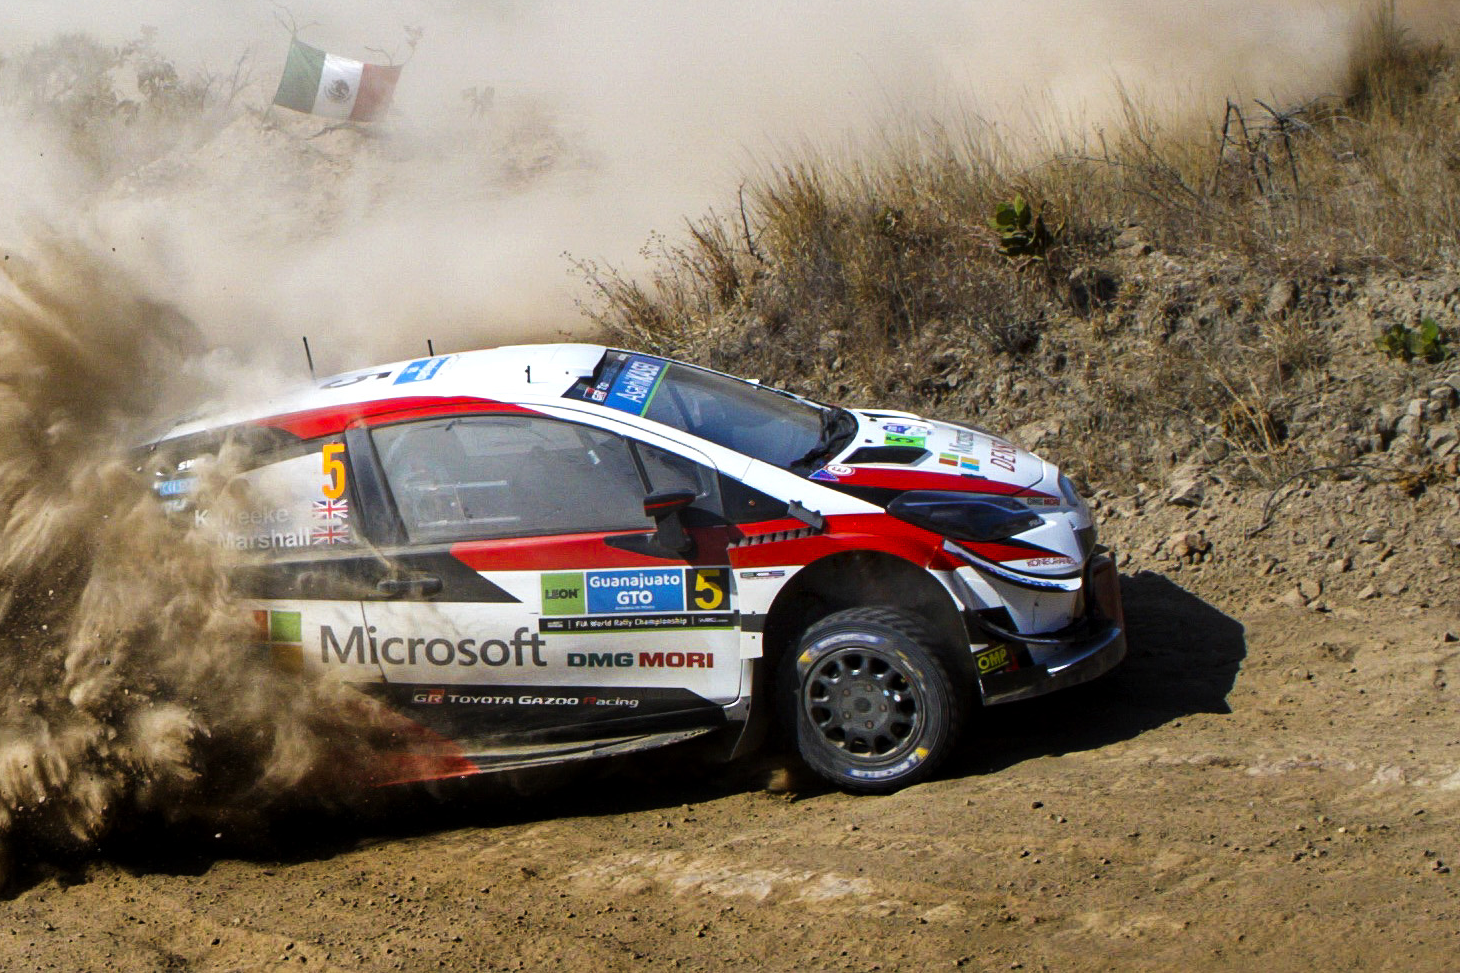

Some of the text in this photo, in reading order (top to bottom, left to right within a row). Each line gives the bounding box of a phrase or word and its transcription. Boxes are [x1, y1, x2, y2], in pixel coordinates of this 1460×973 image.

[322, 443, 346, 498] 5
[589, 572, 681, 589] Guanajuato
[616, 590, 653, 605] GTO
[694, 569, 724, 610] 5
[575, 620, 589, 628] FIA
[590, 619, 612, 628] World
[613, 618, 634, 628] Rally
[634, 616, 688, 627] Championship
[320, 625, 548, 667] Microsoft
[567, 652, 714, 668] DMG MORI
[977, 648, 1008, 670] OMP
[413, 693, 443, 704] GR
[448, 694, 514, 706] TOYOTA
[518, 695, 579, 706] GAZOO
